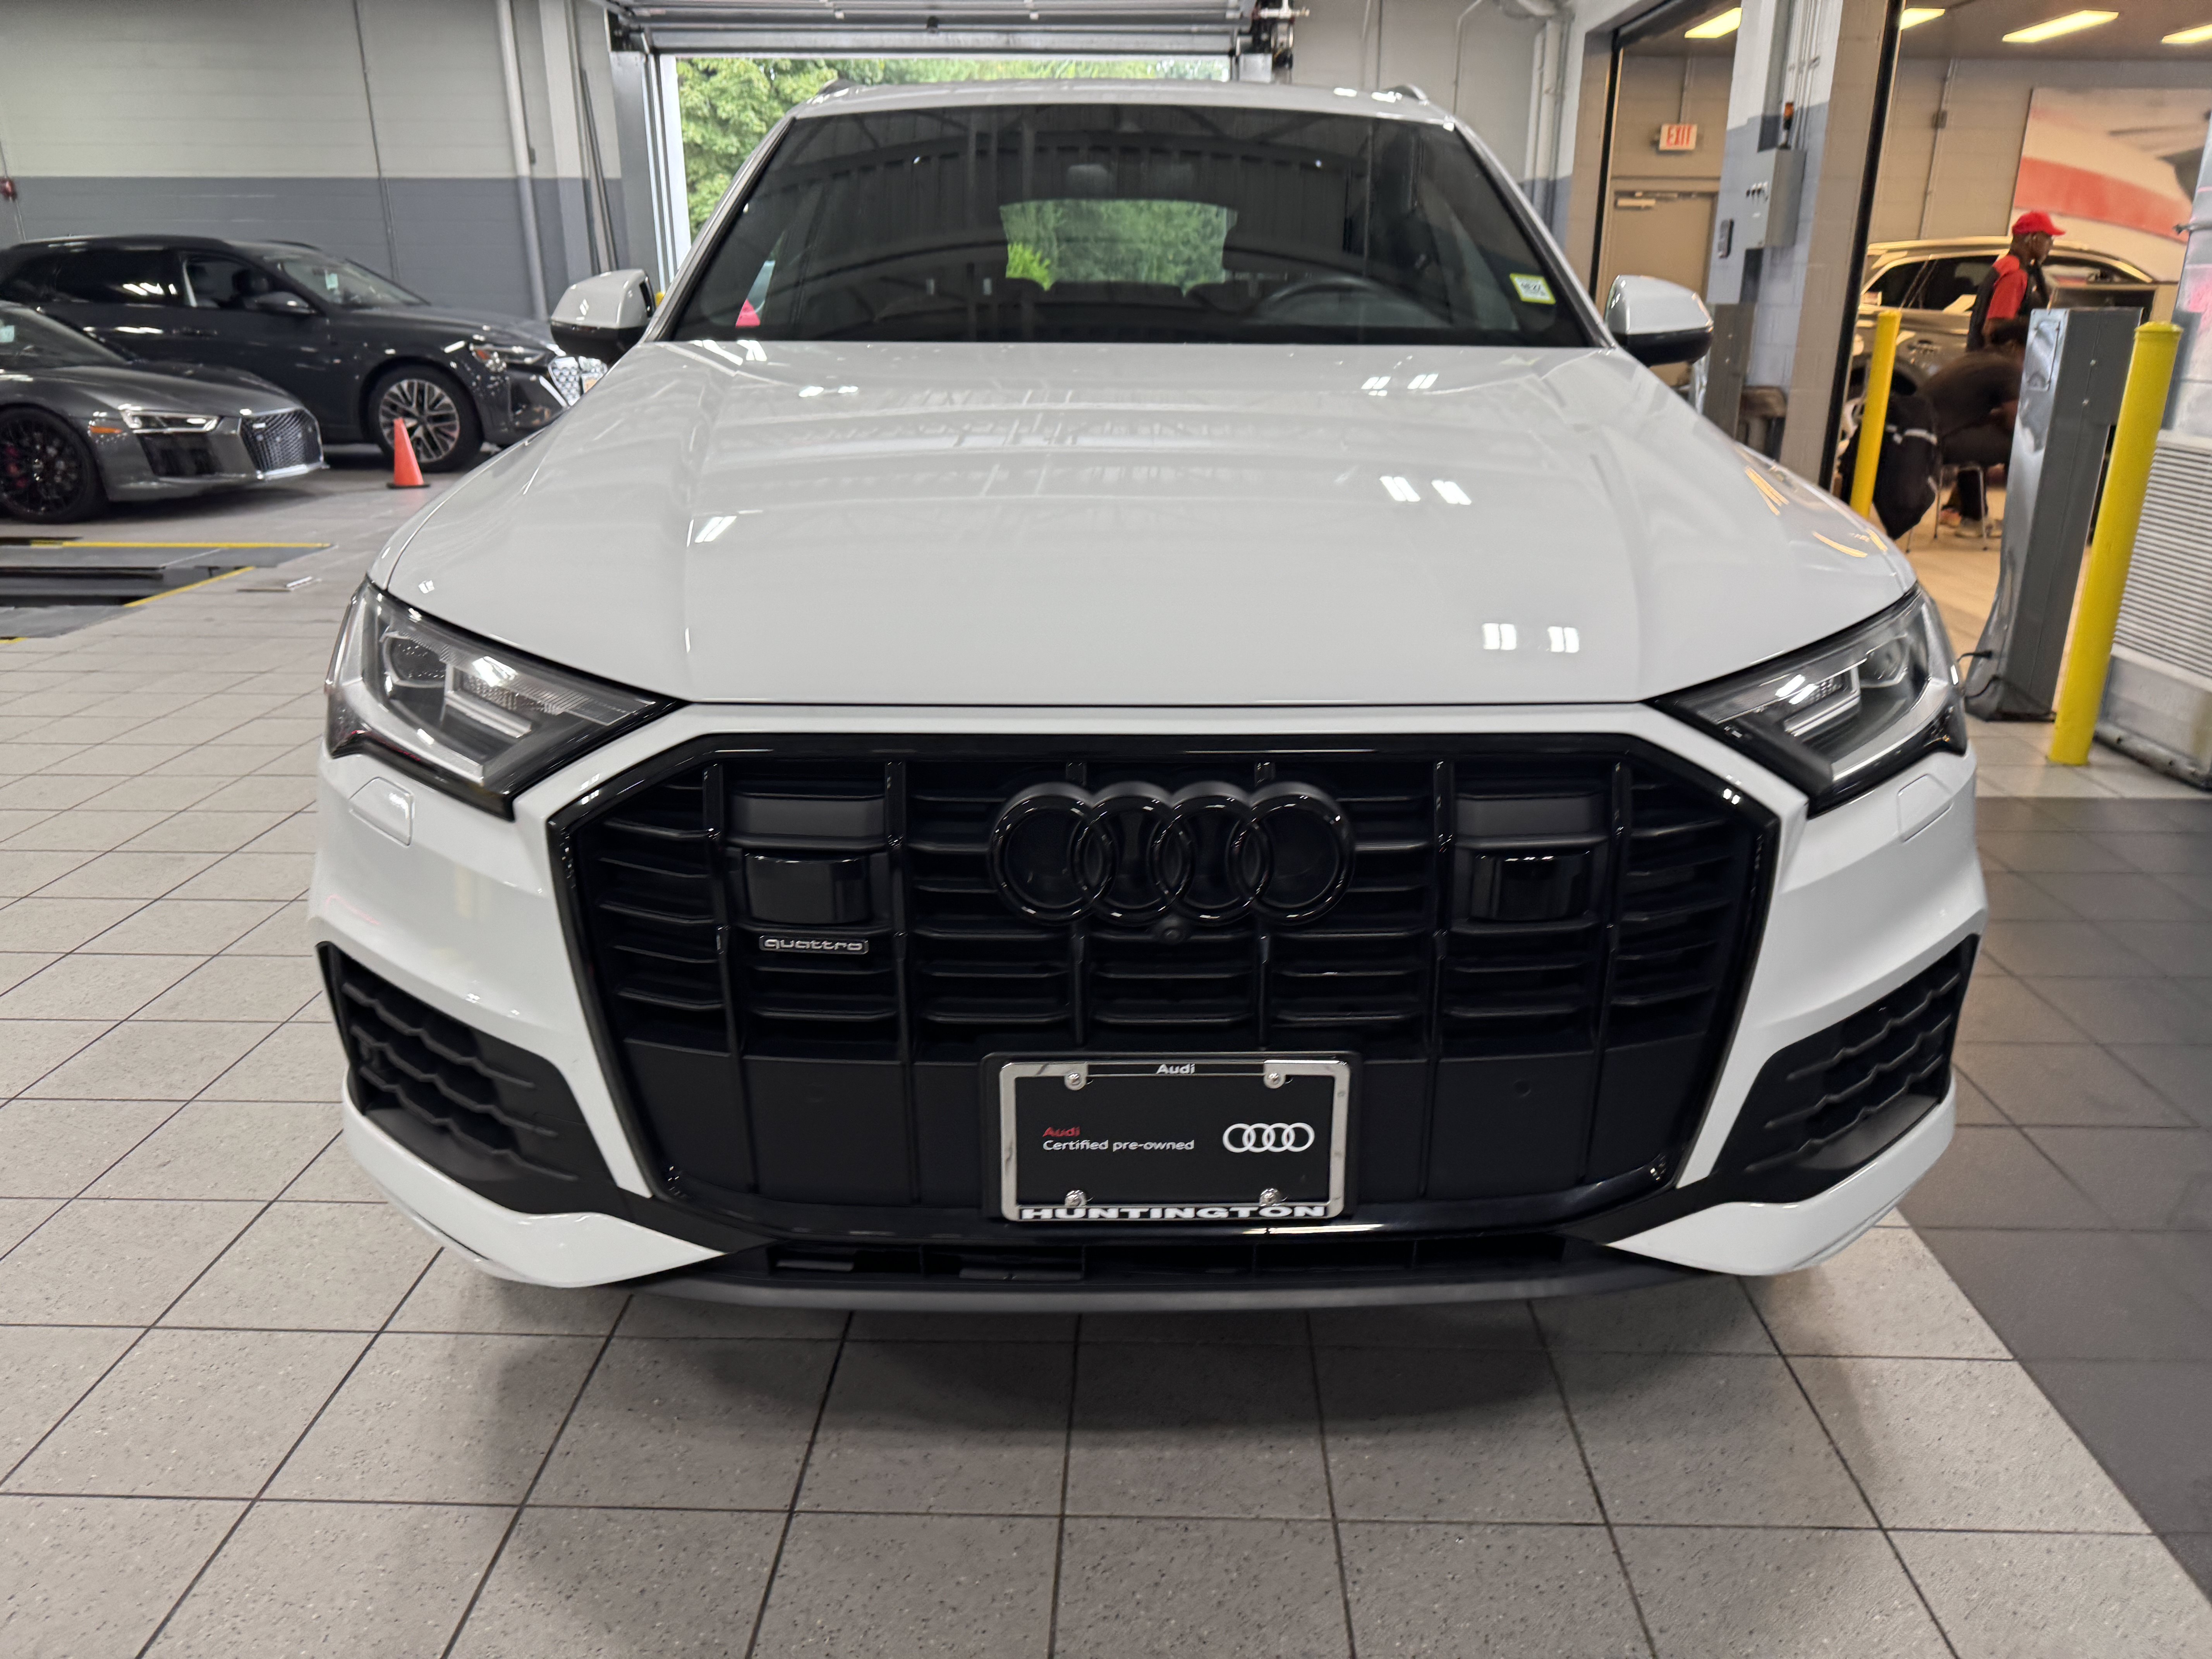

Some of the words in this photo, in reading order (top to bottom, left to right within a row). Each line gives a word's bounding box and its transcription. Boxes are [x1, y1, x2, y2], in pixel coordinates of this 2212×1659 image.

[1667, 125, 1692, 147] EXIT
[764, 939, 862, 950] quattro
[1157, 1064, 1195, 1074] Audi
[1042, 1127, 1080, 1137] Audi
[1043, 1140, 1108, 1151] Certified
[1113, 1140, 1195, 1152] pre-owned
[1022, 1206, 1326, 1219] HUNTINGTON
